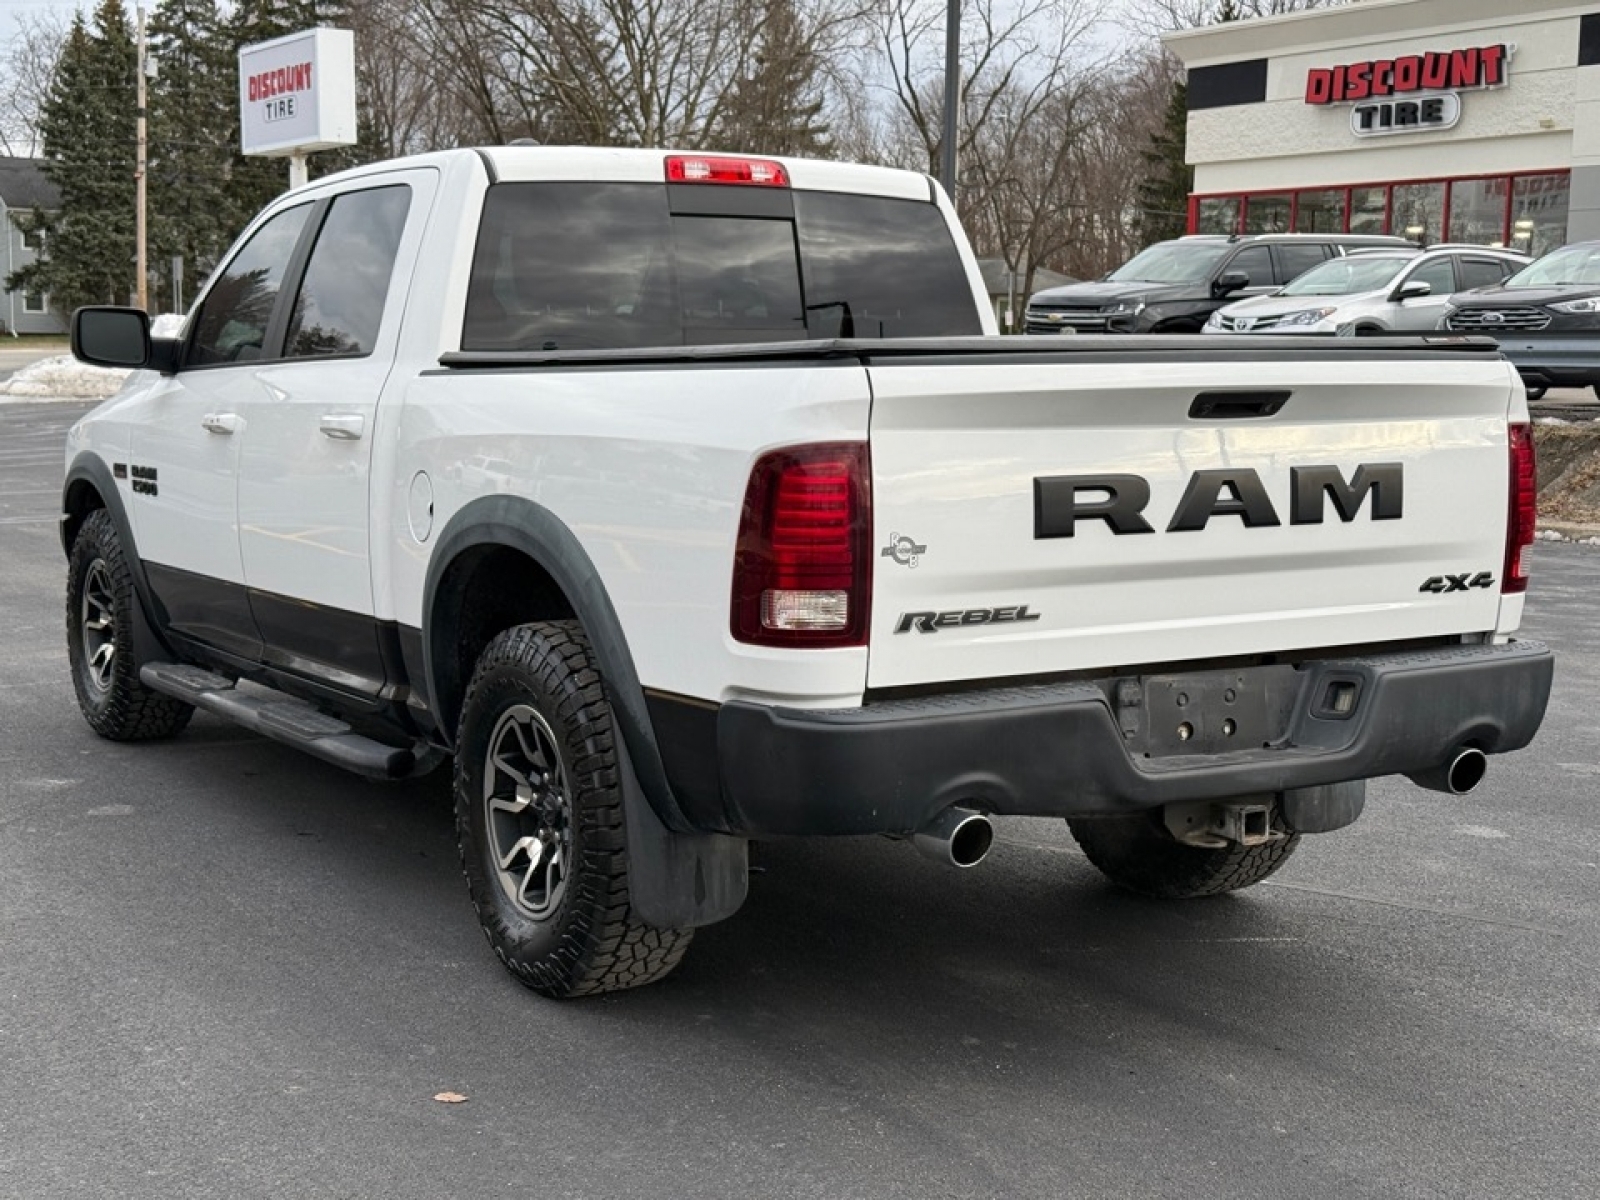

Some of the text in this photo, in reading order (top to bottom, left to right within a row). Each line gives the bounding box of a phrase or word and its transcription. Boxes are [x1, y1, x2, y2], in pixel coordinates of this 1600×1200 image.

[248, 63, 312, 102] DISCOUNT
[1304, 43, 1507, 104] DISCOUNT
[266, 98, 294, 120] TIRE
[1354, 98, 1444, 130] TIRE
[1033, 461, 1404, 540] RAM
[1418, 571, 1496, 594] 4X4
[892, 604, 1042, 634] REBEL
